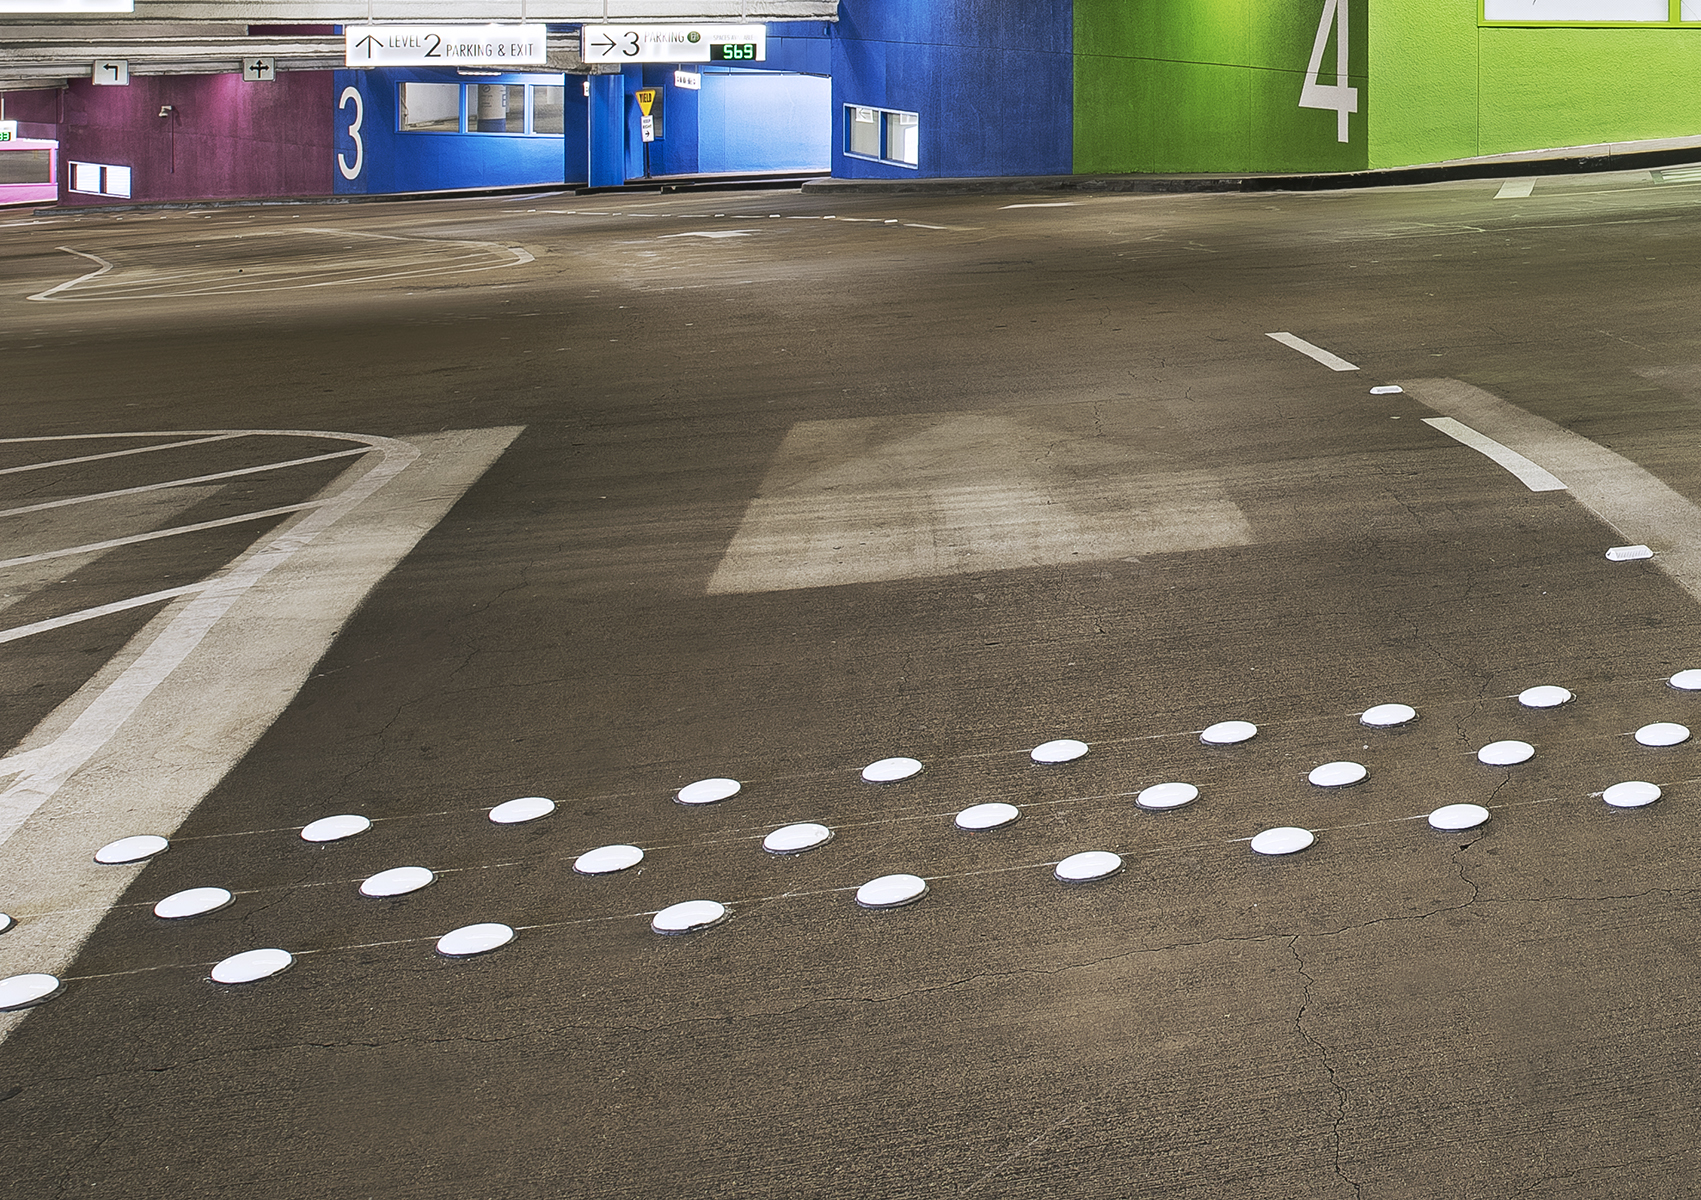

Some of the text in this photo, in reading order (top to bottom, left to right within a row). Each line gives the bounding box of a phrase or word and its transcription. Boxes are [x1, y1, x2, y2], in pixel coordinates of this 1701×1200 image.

[389, 33, 534, 58] LEVEL 2 PARKING & EXIT
[622, 31, 685, 57] 3 PARKING
[723, 44, 753, 60] 569
[639, 93, 652, 103] YIELD
[338, 86, 364, 180] 3
